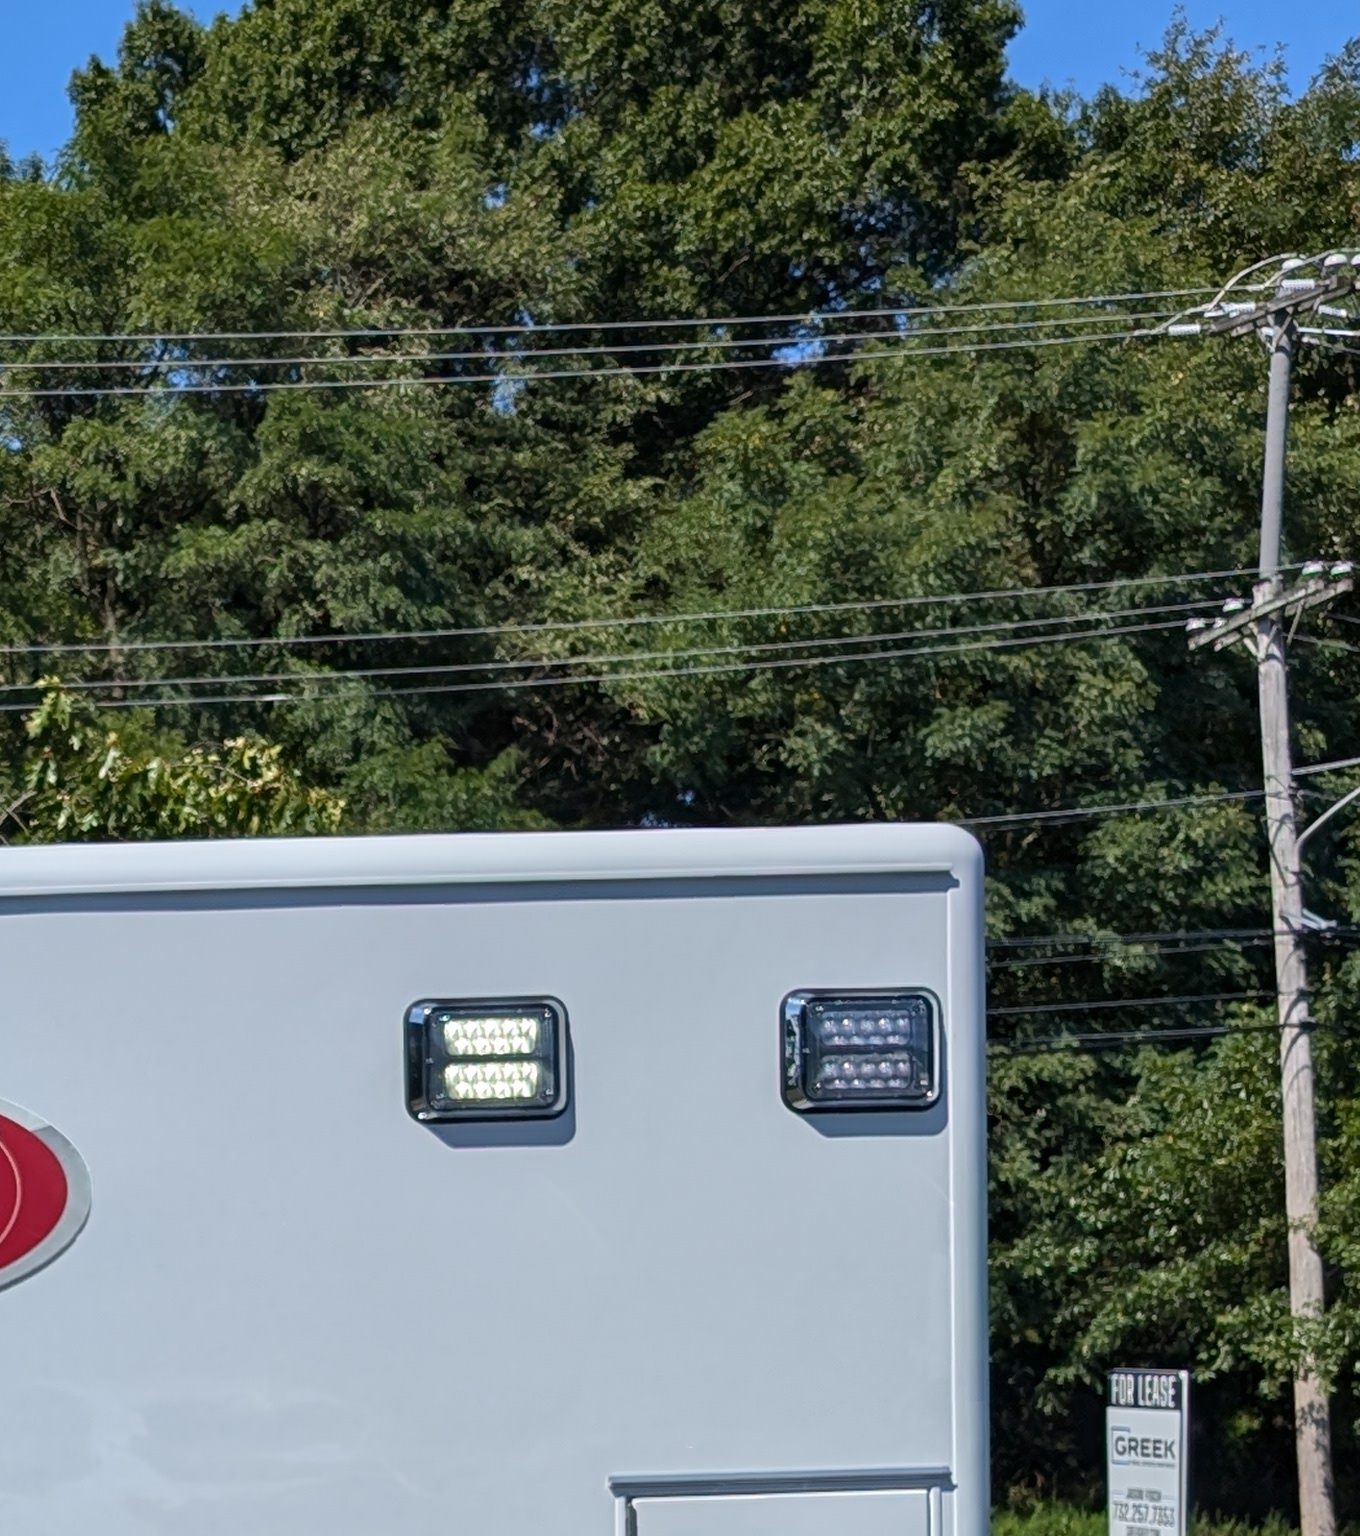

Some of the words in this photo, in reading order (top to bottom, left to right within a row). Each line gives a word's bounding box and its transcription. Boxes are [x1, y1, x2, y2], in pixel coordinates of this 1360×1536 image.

[1111, 1373, 1134, 1405] FOR
[1138, 1375, 1176, 1408] LEASE
[1115, 1436, 1175, 1460] GREEK
